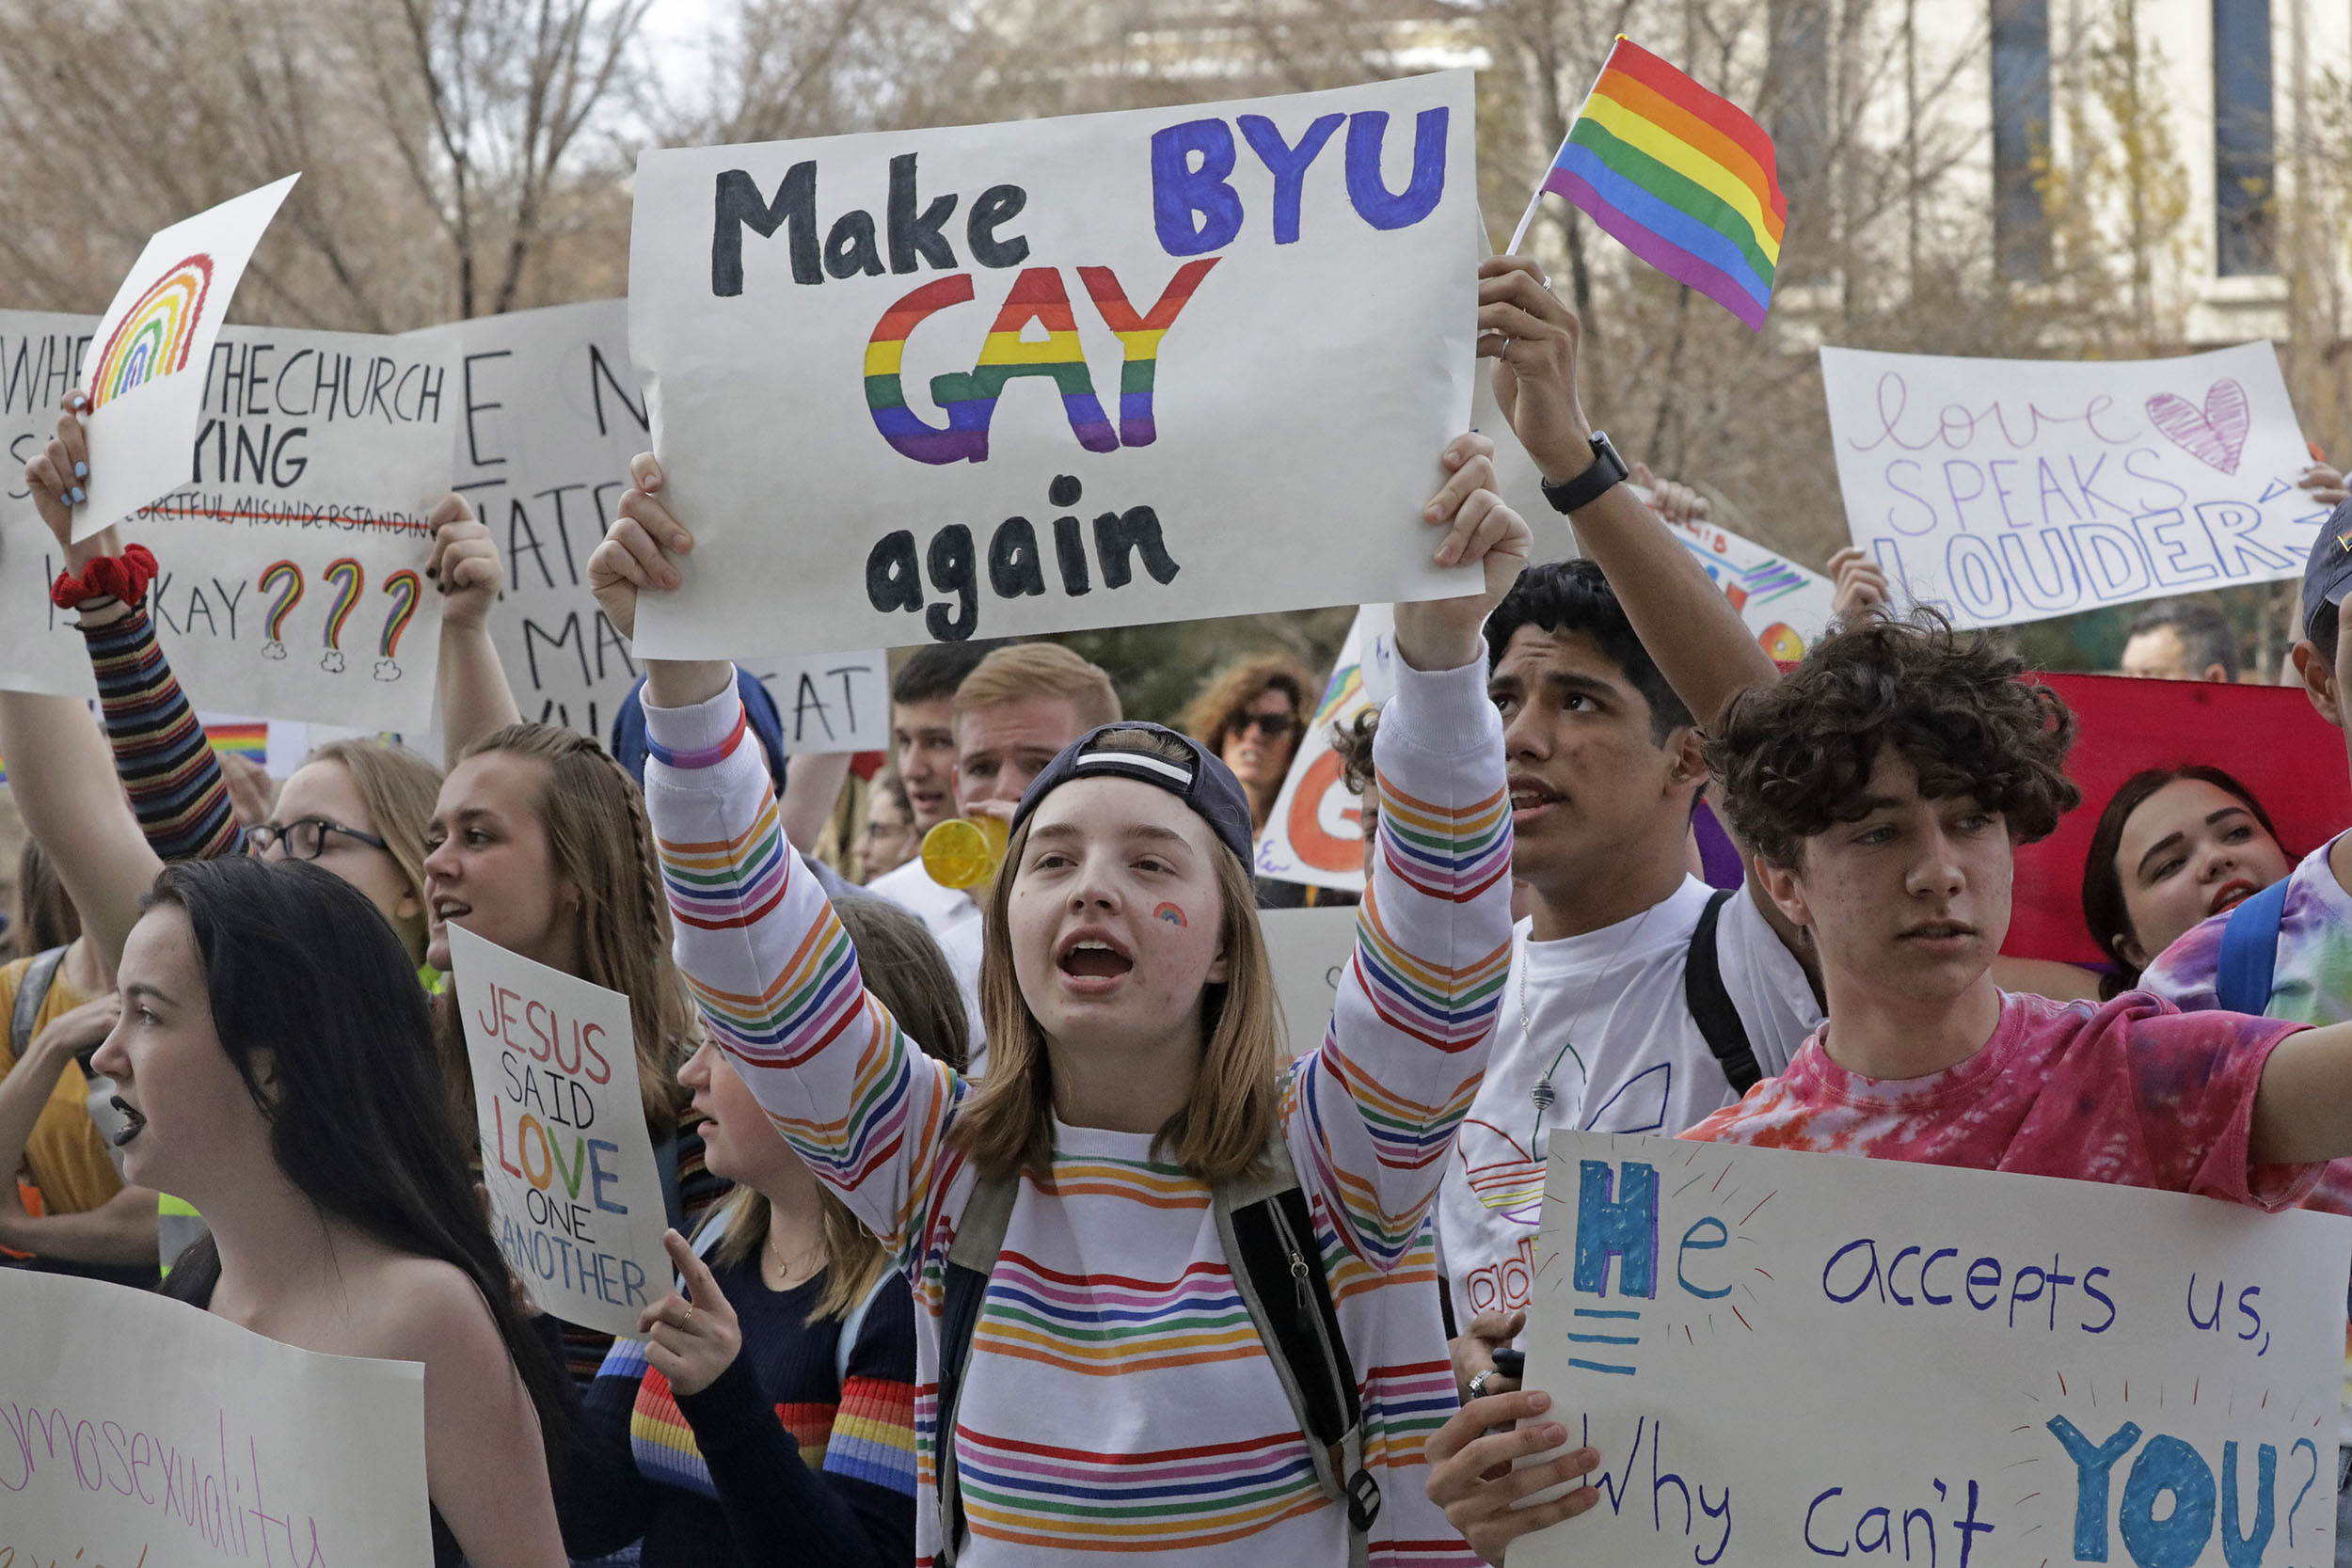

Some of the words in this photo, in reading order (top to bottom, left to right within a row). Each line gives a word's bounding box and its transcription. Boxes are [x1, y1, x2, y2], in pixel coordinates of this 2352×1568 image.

[711, 151, 1030, 297] Make
[1151, 106, 1449, 257] BYU
[202, 341, 275, 417] THE
[276, 348, 445, 424] CHURCH
[863, 257, 1223, 466] GAY
[1850, 372, 2142, 451] love
[230, 496, 437, 542] MISUNDERSTANDIN
[1885, 448, 2187, 537] SPEAKS
[866, 475, 1181, 642] again
[1873, 500, 2296, 622] LOUDER
[479, 983, 611, 1085] JESUS
[501, 1051, 595, 1129] SAID
[494, 1095, 628, 1215] LOVE
[500, 1212, 648, 1307] ANOTHER
[526, 1188, 596, 1244] ONE
[1573, 1159, 1733, 1301] He
[1822, 1238, 2117, 1334] accepts
[2187, 1272, 2272, 1356] us,
[1583, 1413, 1731, 1565] Why
[2045, 1414, 2318, 1568] YOU?
